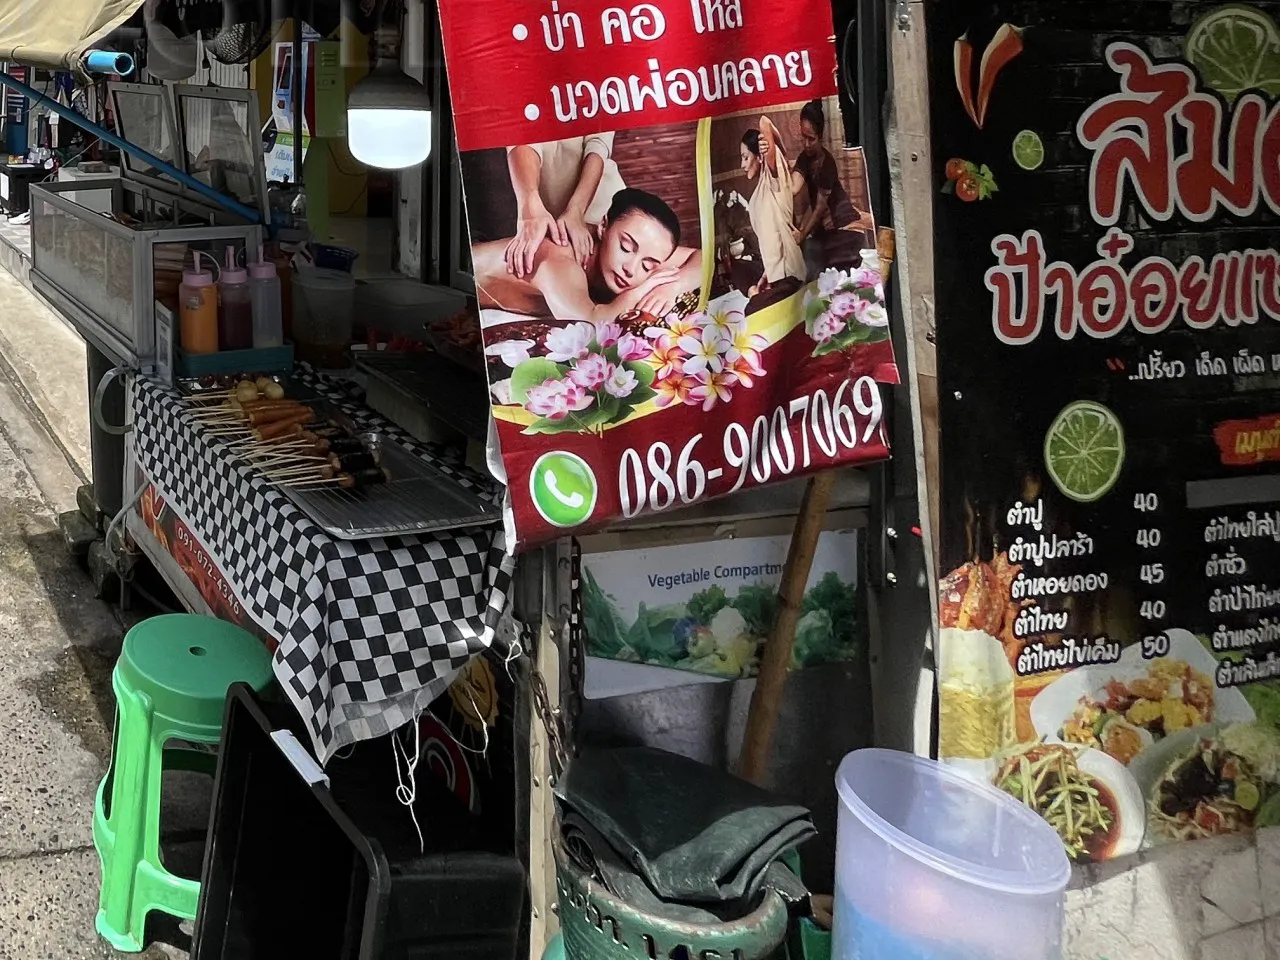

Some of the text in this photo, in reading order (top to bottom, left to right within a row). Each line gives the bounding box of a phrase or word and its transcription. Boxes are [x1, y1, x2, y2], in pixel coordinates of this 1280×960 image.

[539, 1, 585, 52] บ่า
[601, 3, 666, 45] คอ
[550, 49, 813, 123] นวดผ่อนคลาย
[619, 375, 884, 518] 086-9007069
[1007, 492, 1158, 531] ตำปู 40
[1008, 528, 1161, 567] ตำปูปลาร้า 40
[177, 526, 240, 615] 091-072-4346
[647, 562, 783, 590] Vegetable Compartm
[1011, 563, 1165, 599] ตำหอยดอง 45
[1014, 600, 1166, 637] ตำไทย 40
[1018, 636, 1168, 674] ตำไทยไข่เค็ม 50
